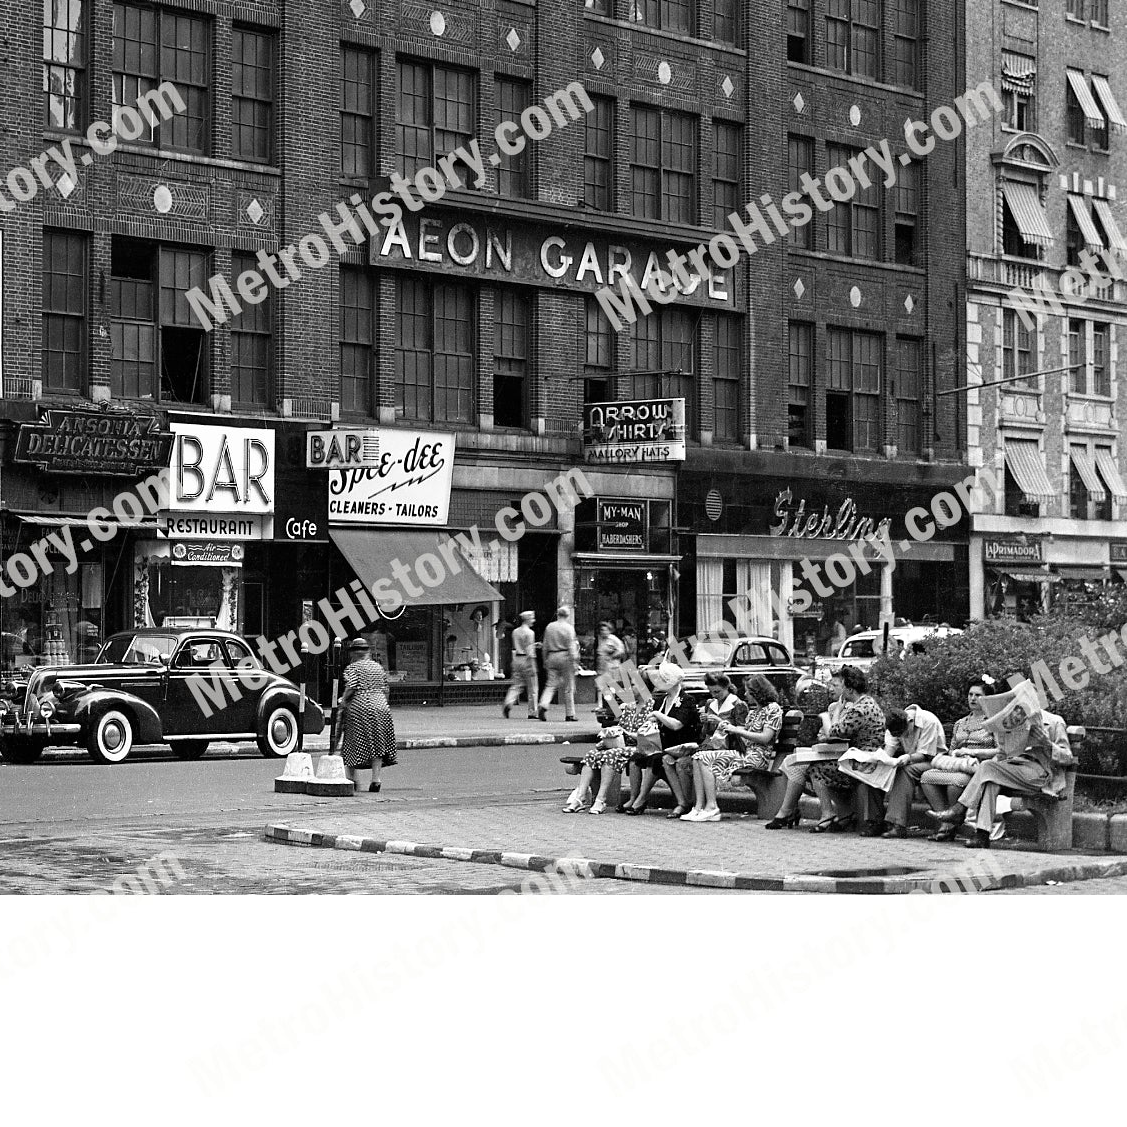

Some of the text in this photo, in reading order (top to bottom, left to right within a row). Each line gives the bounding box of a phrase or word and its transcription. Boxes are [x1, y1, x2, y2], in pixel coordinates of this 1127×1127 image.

[380, 217, 728, 300] AEON GARAGE
[57, 415, 142, 436] ANSONIA
[590, 404, 670, 432] ARROW
[608, 422, 666, 440] SHIRTS
[27, 433, 163, 460] DELICATESSEN
[310, 435, 362, 464] BAR
[589, 446, 671, 459] MALLORY HATS
[177, 433, 271, 503] BAR
[329, 500, 439, 518] CLEANERS TAILORS
[604, 506, 641, 521] MY-MAN
[167, 518, 254, 536] RESTAURANT
[286, 517, 317, 539] Cafe
[769, 486, 892, 559] Sterling
[203, 542, 216, 552] Air
[602, 533, 643, 545] HABERDASHERS
[188, 550, 230, 561] Conditioned
